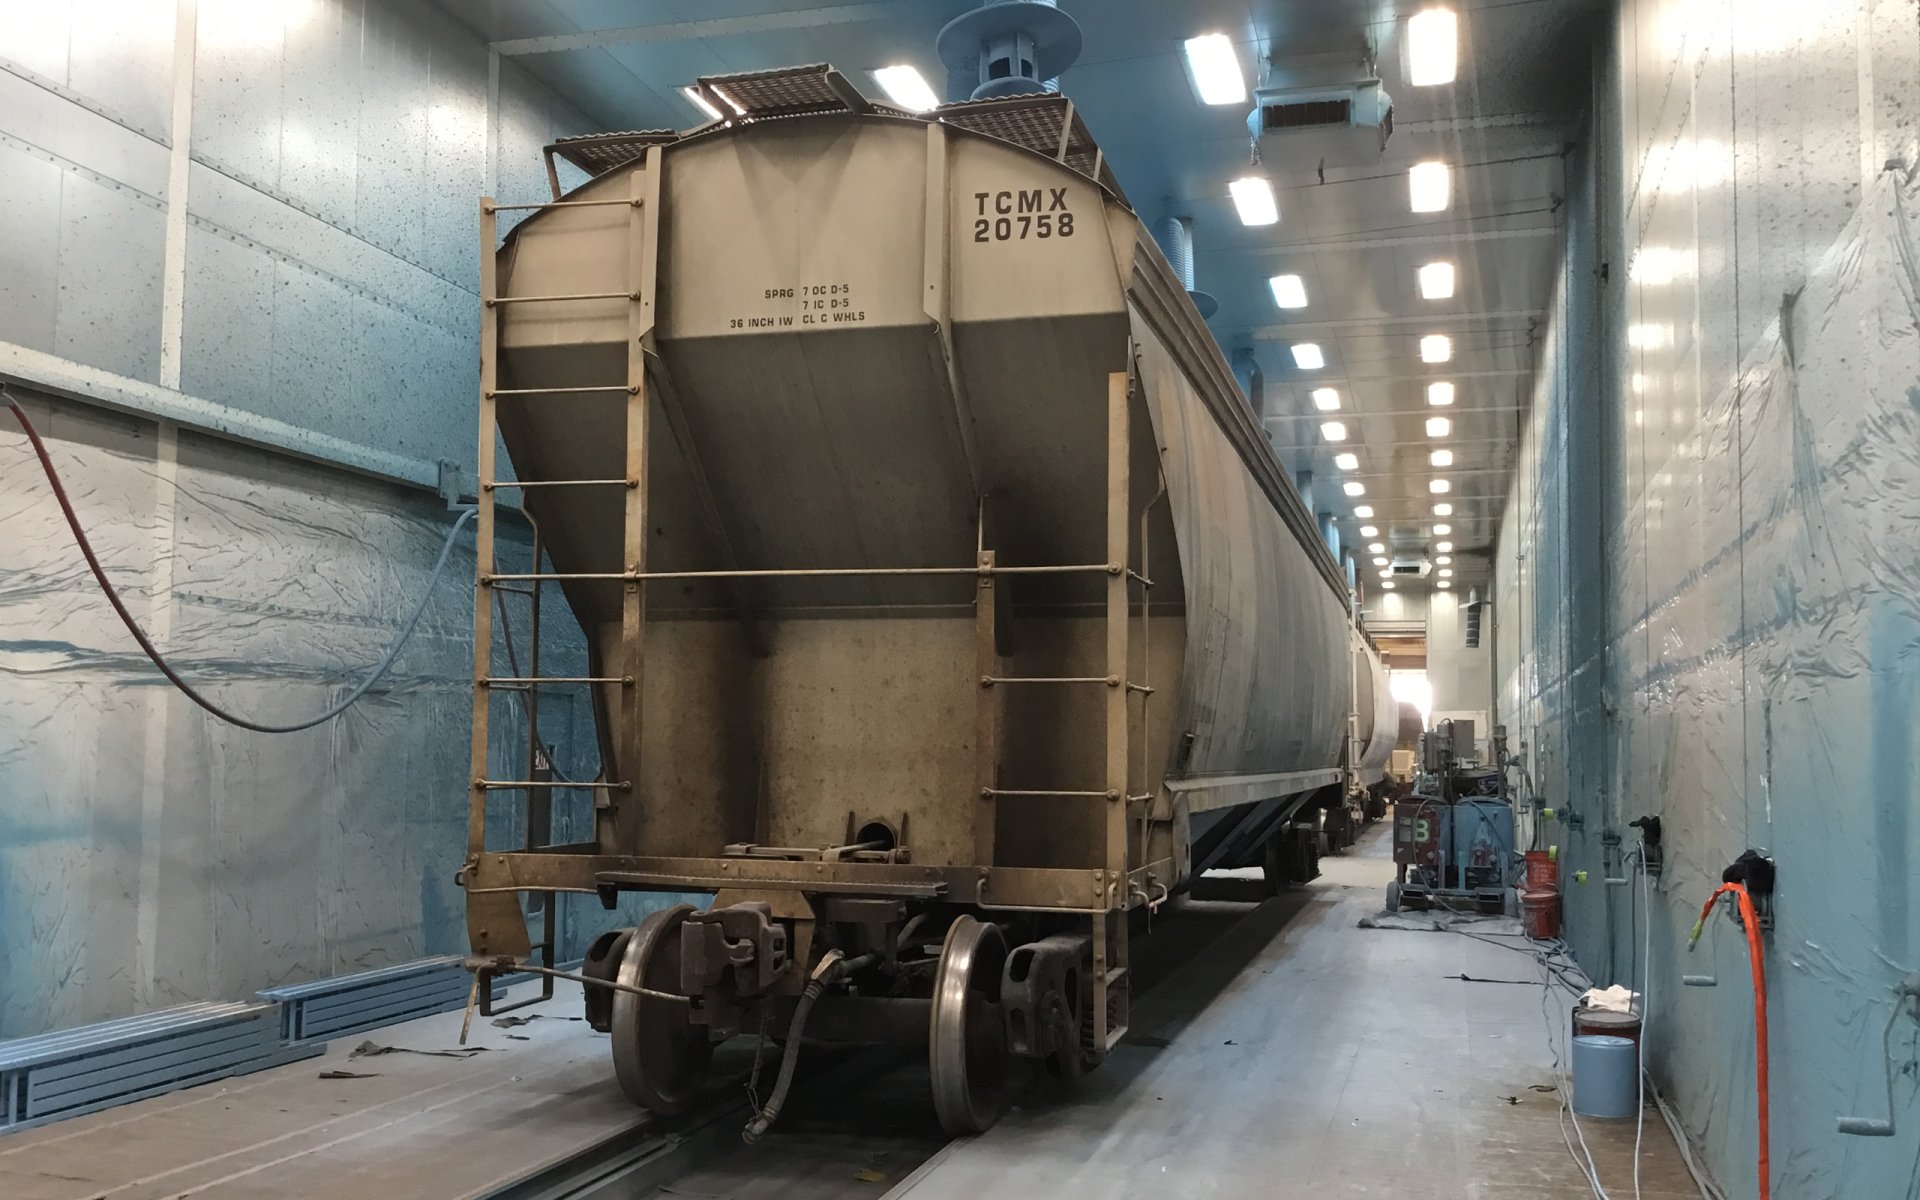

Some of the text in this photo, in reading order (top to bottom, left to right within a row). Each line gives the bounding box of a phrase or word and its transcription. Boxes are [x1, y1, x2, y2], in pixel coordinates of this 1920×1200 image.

[974, 187, 1068, 216] TCMX
[974, 212, 1074, 243] 20758
[764, 288, 794, 299] SPRG
[803, 286, 809, 296] 7
[830, 283, 849, 295] D-5
[803, 300, 809, 310] 7
[830, 298, 849, 309] D-5
[730, 319, 743, 329] 36
[748, 317, 774, 328] INCH
[779, 316, 794, 326] IW
[802, 314, 815, 324] CL
[833, 311, 865, 322] WHLS
